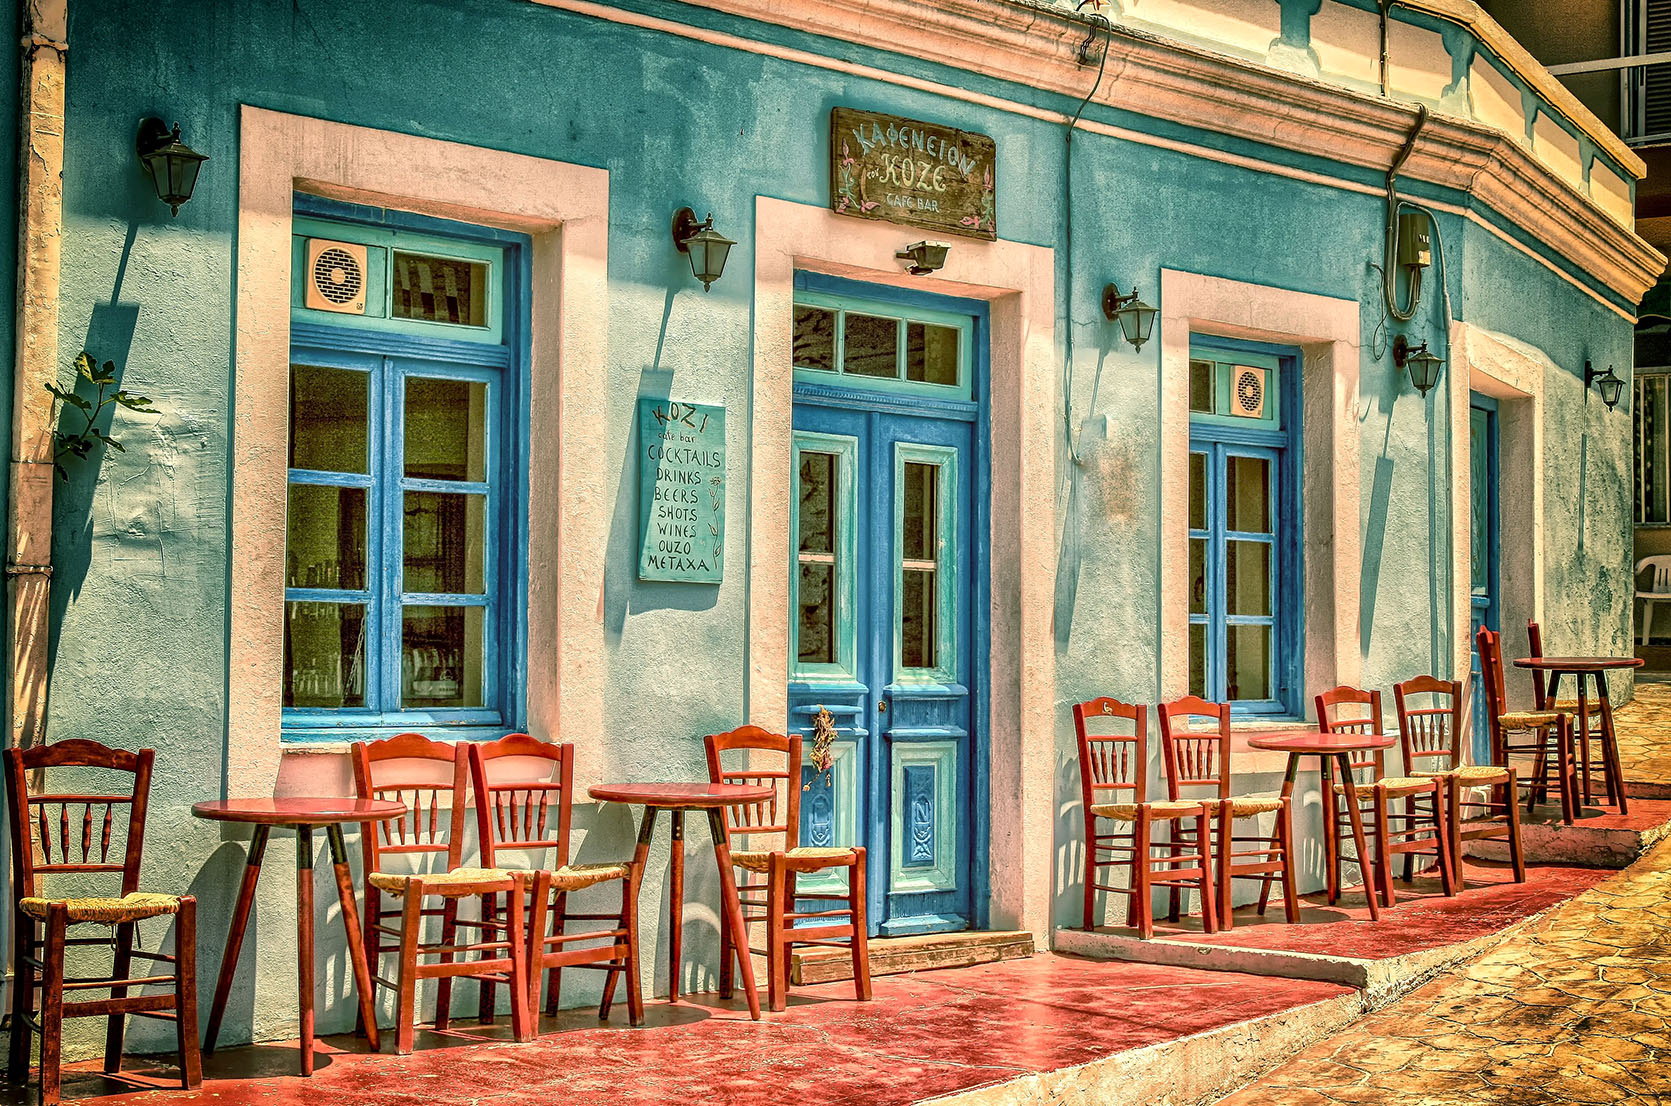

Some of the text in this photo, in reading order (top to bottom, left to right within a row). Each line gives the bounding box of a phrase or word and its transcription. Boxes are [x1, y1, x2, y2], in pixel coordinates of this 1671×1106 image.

[886, 193, 940, 213] CAFE BAR
[652, 402, 709, 433] KOZI
[658, 430, 696, 443] cafe bar
[648, 444, 721, 468] COCKTAILS
[656, 467, 702, 485] DRINKS
[654, 486, 699, 504] BEERS
[658, 505, 698, 521] SHOTS
[657, 522, 697, 538] WINES
[658, 540, 691, 555] OUZO
[647, 555, 710, 572] METAXA
